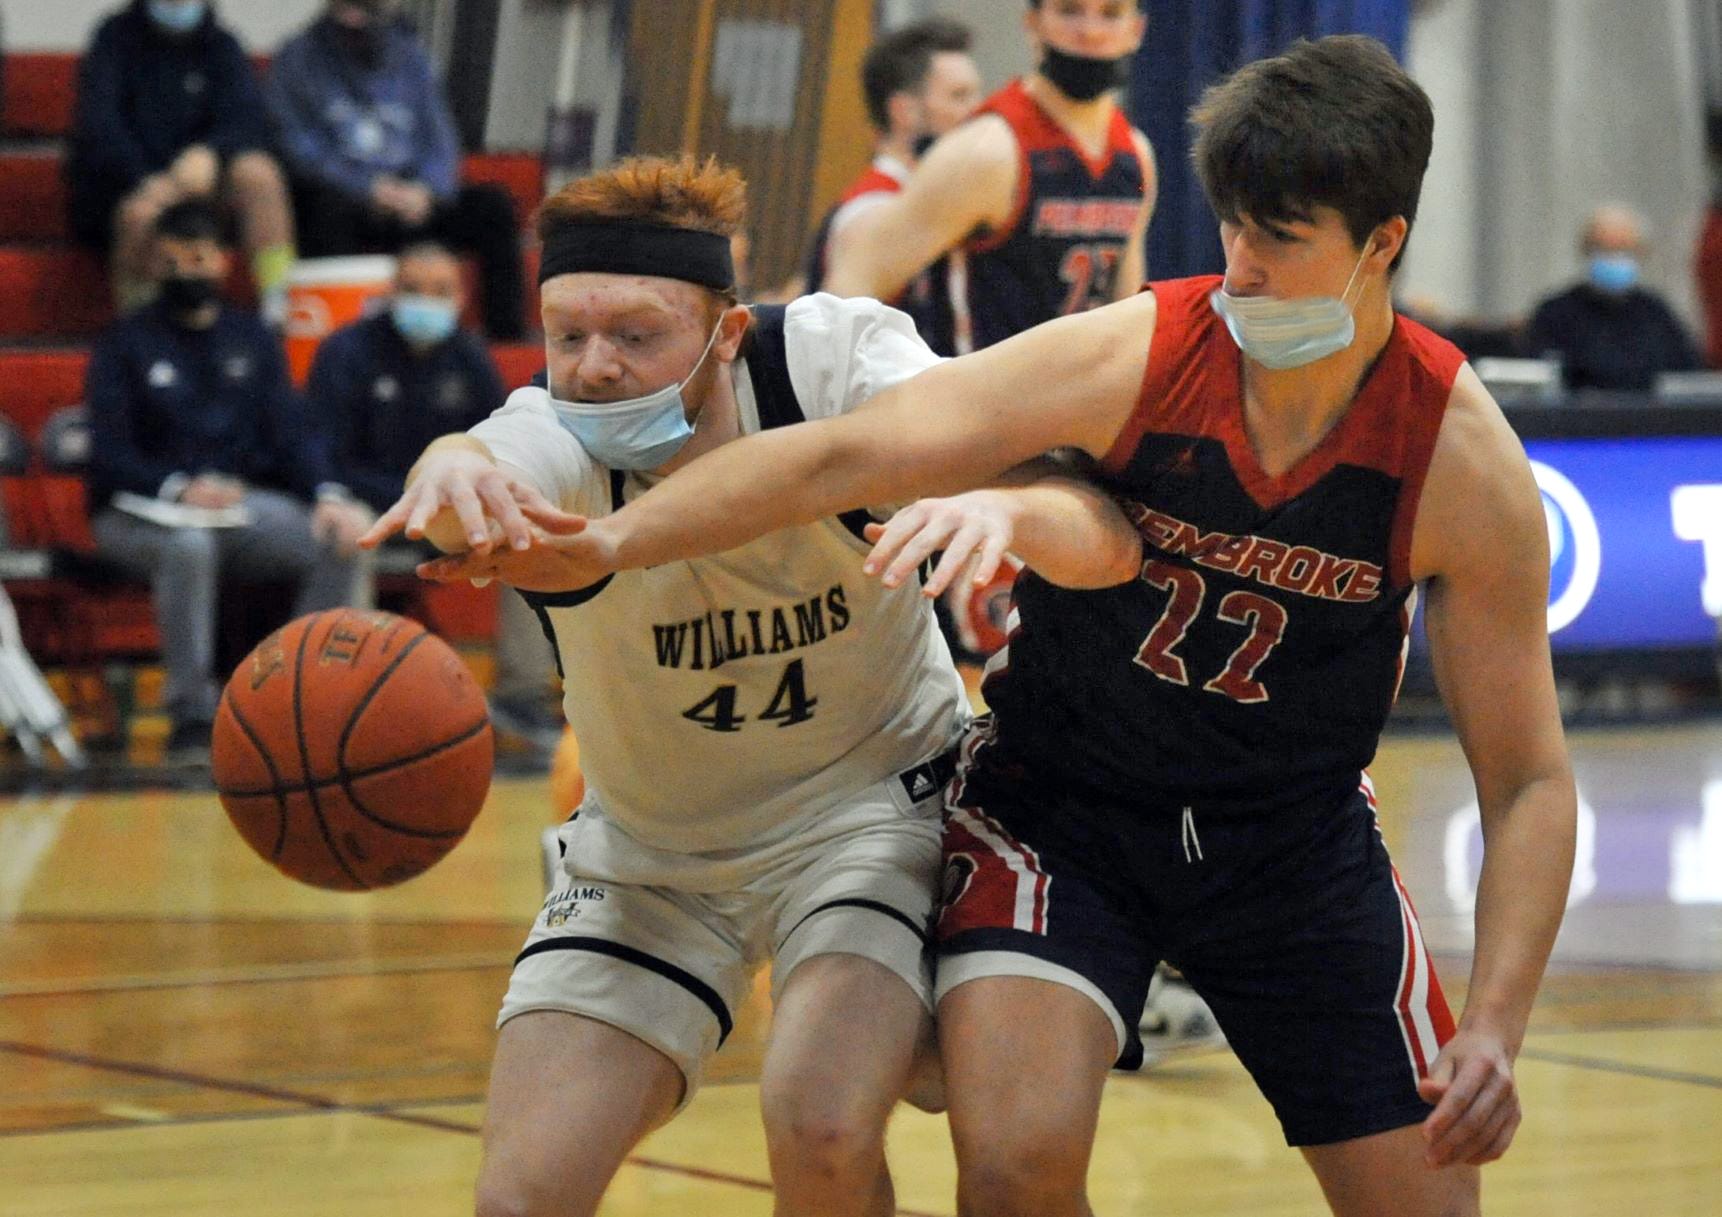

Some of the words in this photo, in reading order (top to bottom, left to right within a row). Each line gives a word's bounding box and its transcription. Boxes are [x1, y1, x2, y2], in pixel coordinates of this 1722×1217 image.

[653, 583, 850, 670] WILLIAMS
[1133, 559, 1288, 704] 22
[682, 657, 818, 732] 44
